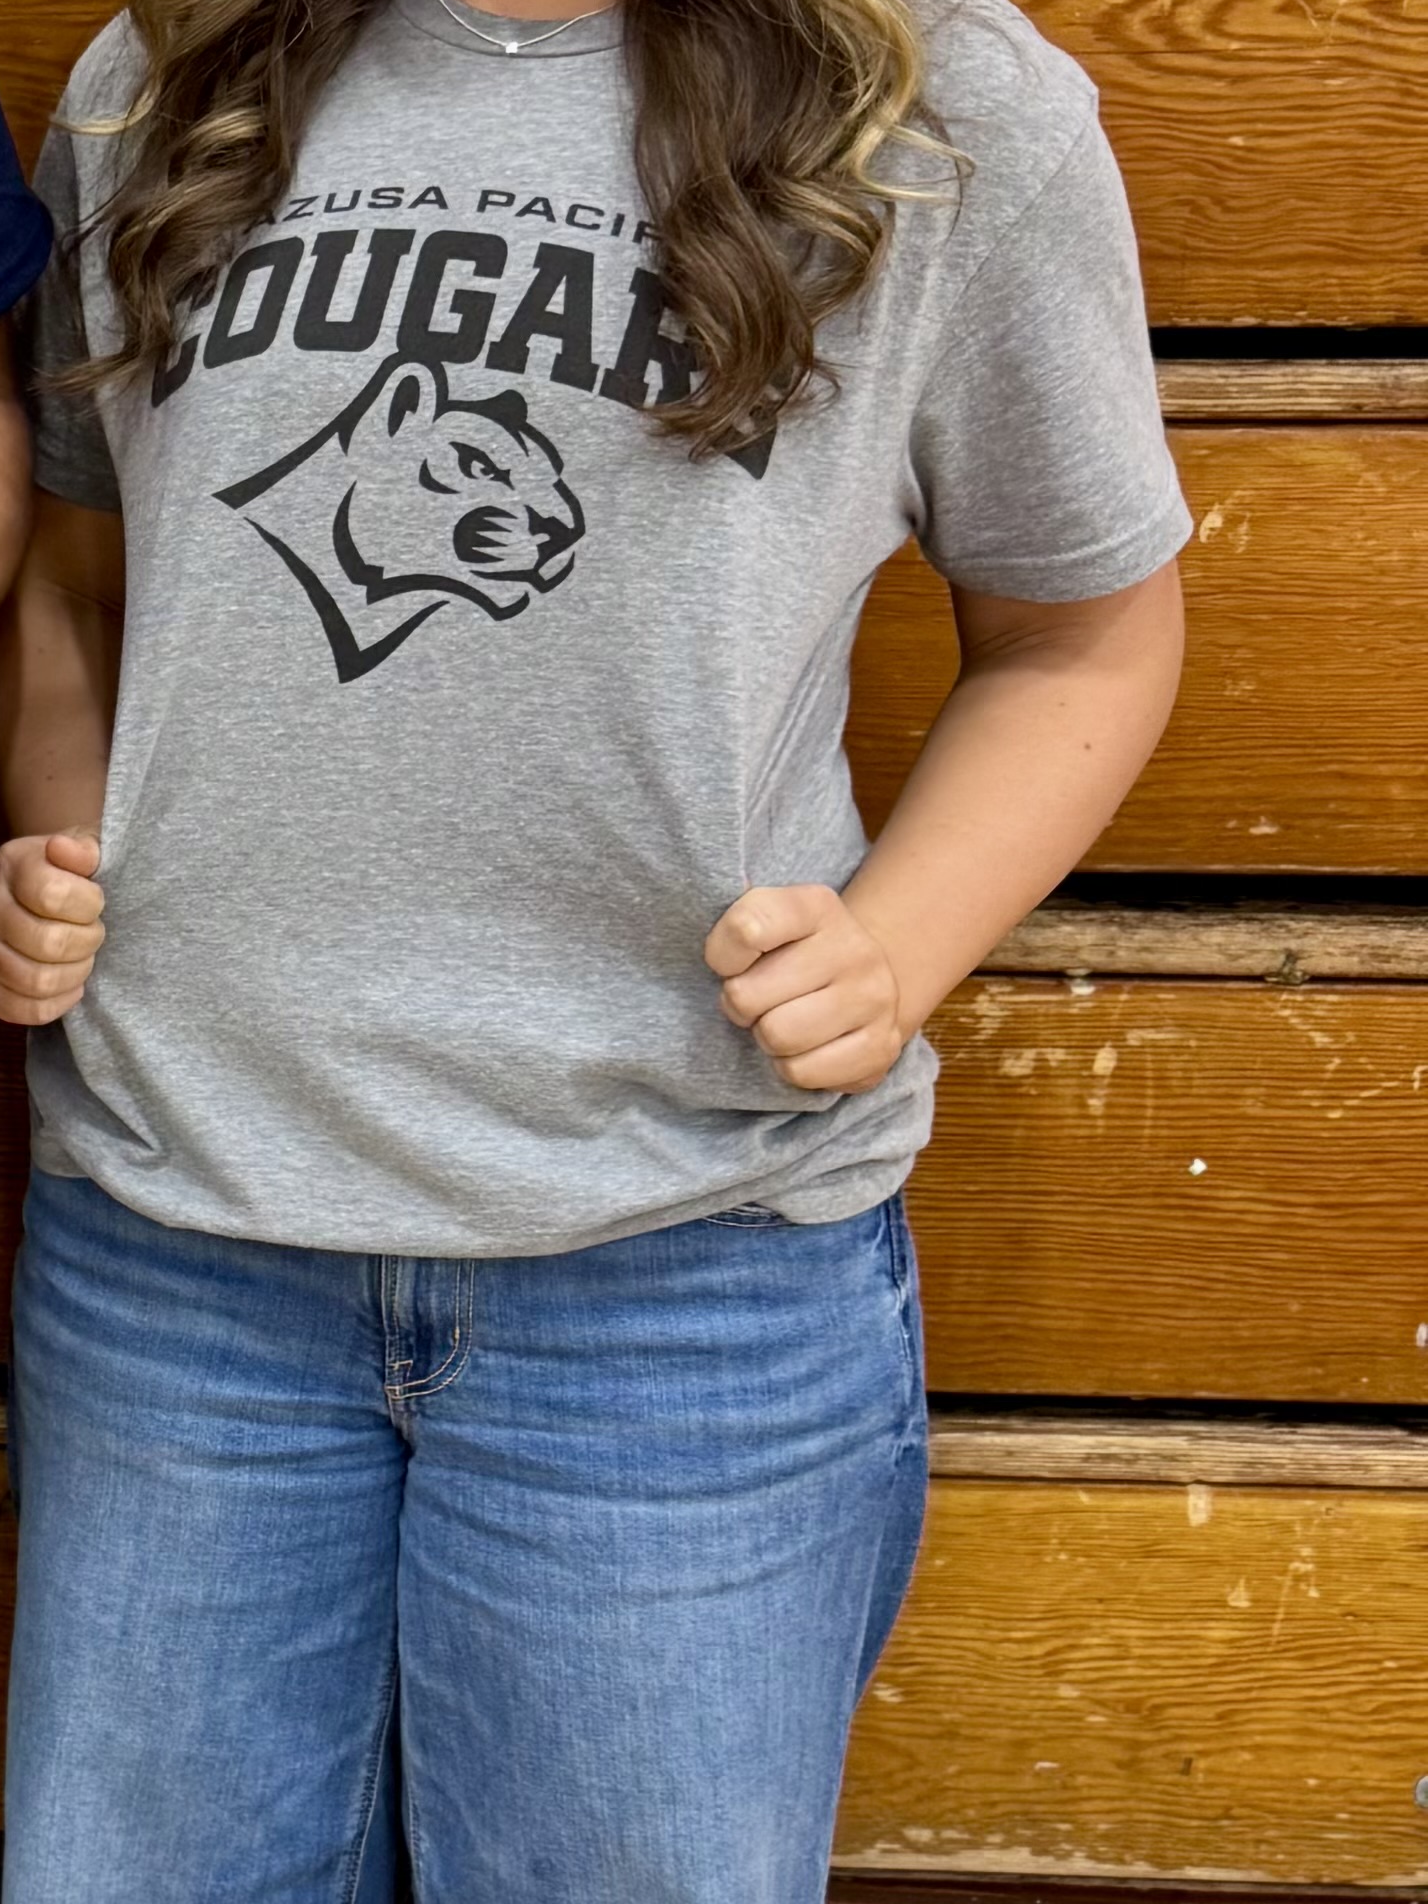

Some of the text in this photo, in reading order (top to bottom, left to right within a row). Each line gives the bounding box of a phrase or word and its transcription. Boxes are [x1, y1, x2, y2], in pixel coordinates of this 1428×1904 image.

[244, 185, 664, 243] ZUSA PACIF
[152, 230, 780, 480] COUGAR
